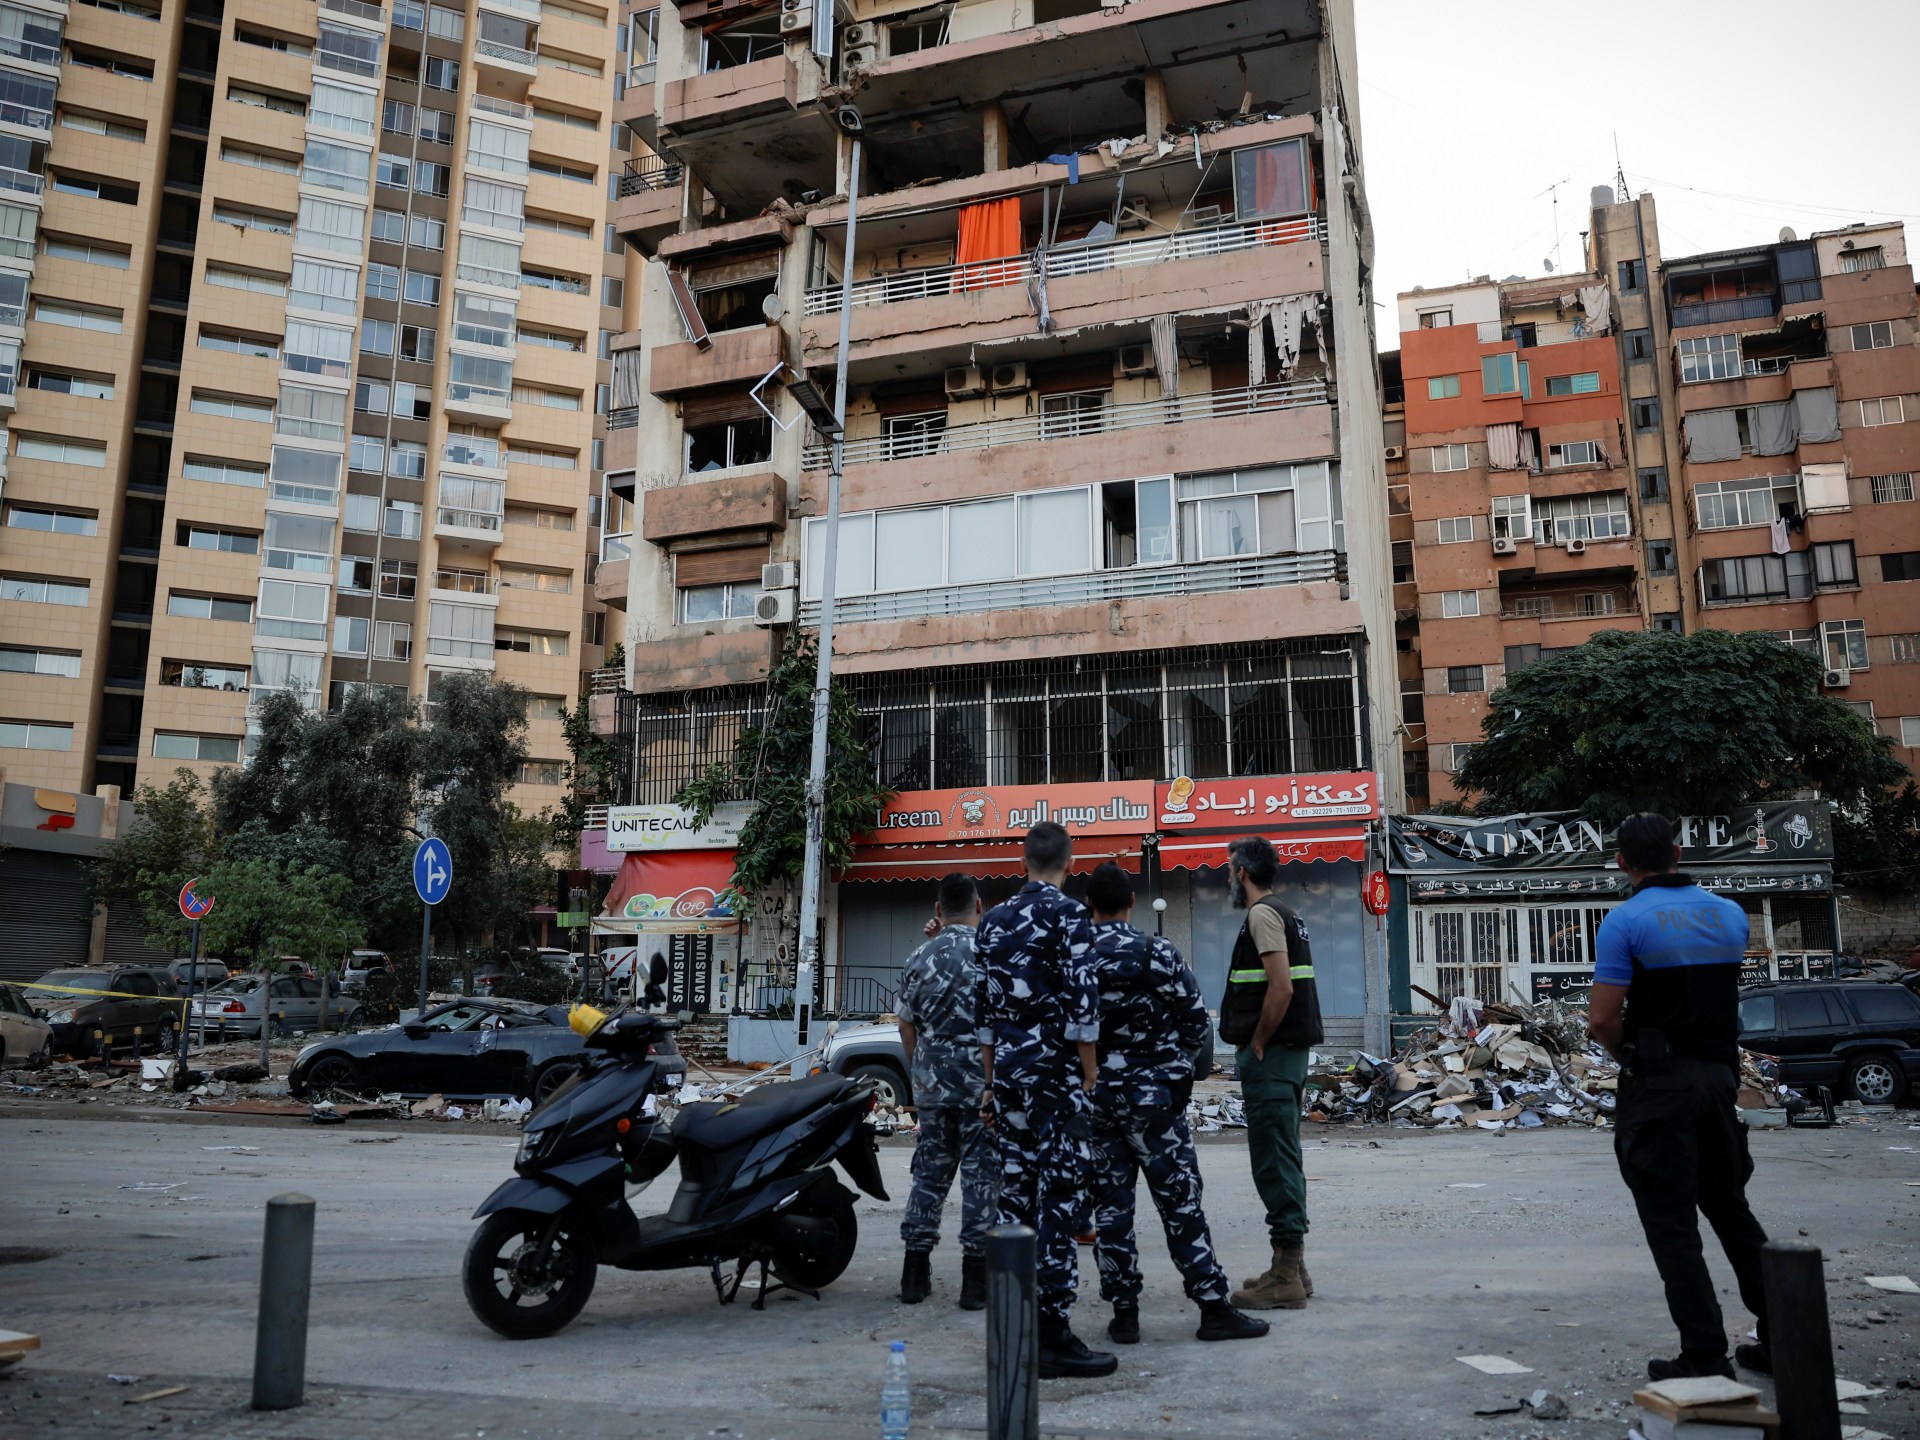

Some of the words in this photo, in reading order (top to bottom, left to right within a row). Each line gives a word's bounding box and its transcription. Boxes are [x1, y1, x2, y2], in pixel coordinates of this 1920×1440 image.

[1265, 779, 1299, 814] أبو
[1304, 782, 1369, 804] كعكة
[1099, 798, 1149, 820] سناك
[1196, 788, 1255, 815] إياد
[1007, 800, 1049, 829] الريم
[1053, 806, 1097, 827] ميس
[612, 817, 703, 833] UNITECAL
[958, 830, 967, 838] 70
[970, 829, 985, 837] 176
[987, 828, 1001, 836] 171
[1401, 822, 1428, 831] coffee
[1457, 820, 1605, 861] ADNAN
[1680, 815, 1734, 848] FE
[1278, 843, 1312, 857] كعكة
[1418, 880, 1445, 890] coffee
[1476, 879, 1515, 894] كافيه
[1519, 879, 1562, 893] عدنان
[1696, 876, 1733, 892] كافيه
[1736, 873, 1778, 891] عدنان
[1655, 906, 1727, 933] POLICE
[1536, 976, 1552, 984] coffee
[1740, 971, 1768, 979] ADNAN
